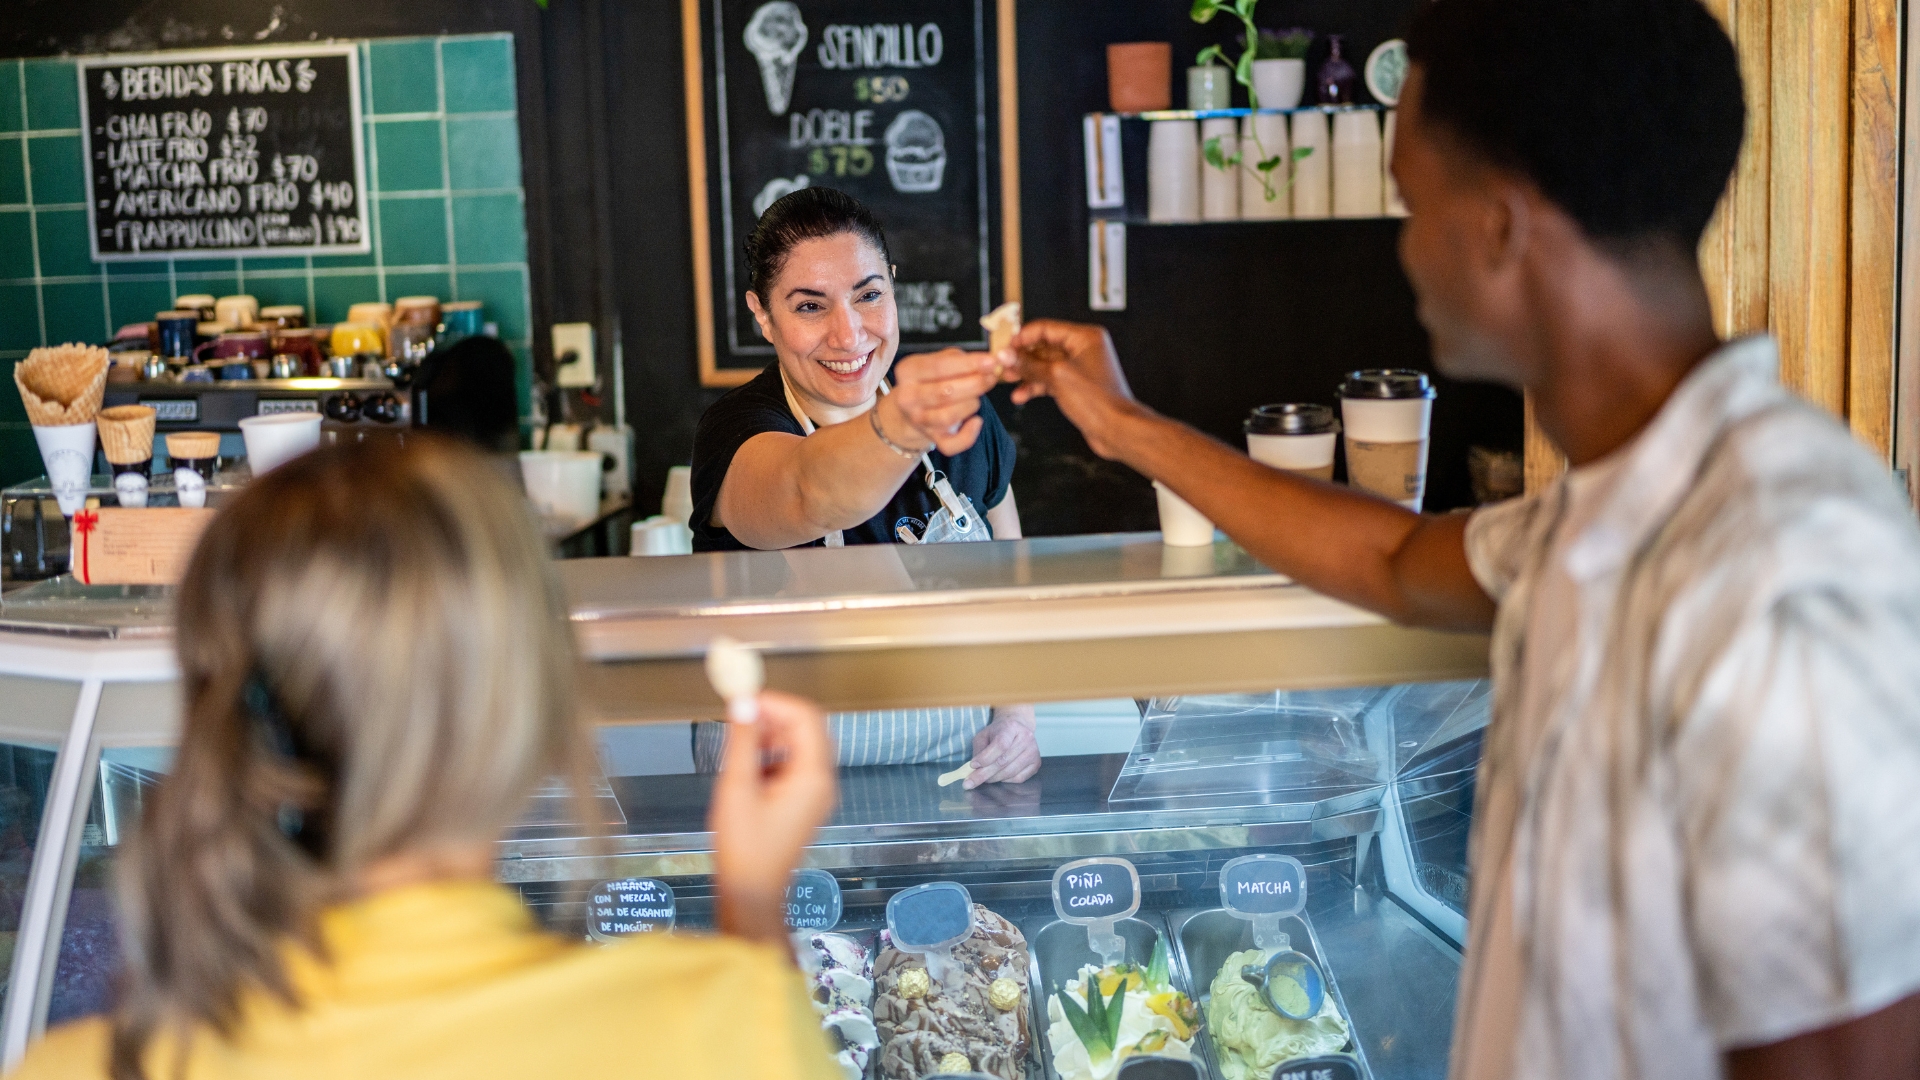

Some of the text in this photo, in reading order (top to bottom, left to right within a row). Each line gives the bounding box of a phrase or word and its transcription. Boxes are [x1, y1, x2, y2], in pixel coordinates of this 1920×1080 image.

[817, 22, 943, 69] SENCILLO
[121, 64, 213, 100] BEBIDAS
[106, 112, 158, 140] CHAI
[789, 108, 875, 147] DOBLE
[808, 145, 874, 177] $75
[113, 161, 205, 190] MATCHA
[271, 152, 319, 182] $70
[113, 186, 241, 217] AMERICANO
[606, 881, 656, 892] NARANJA
[797, 886, 814, 899] DE
[1237, 880, 1292, 895] MATCHA
[594, 892, 667, 904] CON MEZCAL Y
[1069, 893, 1114, 908] COLADA
[597, 908, 615, 917] SAL
[616, 907, 629, 917] DE
[805, 903, 826, 915] CON
[601, 921, 654, 932] DE MAGÜEY
